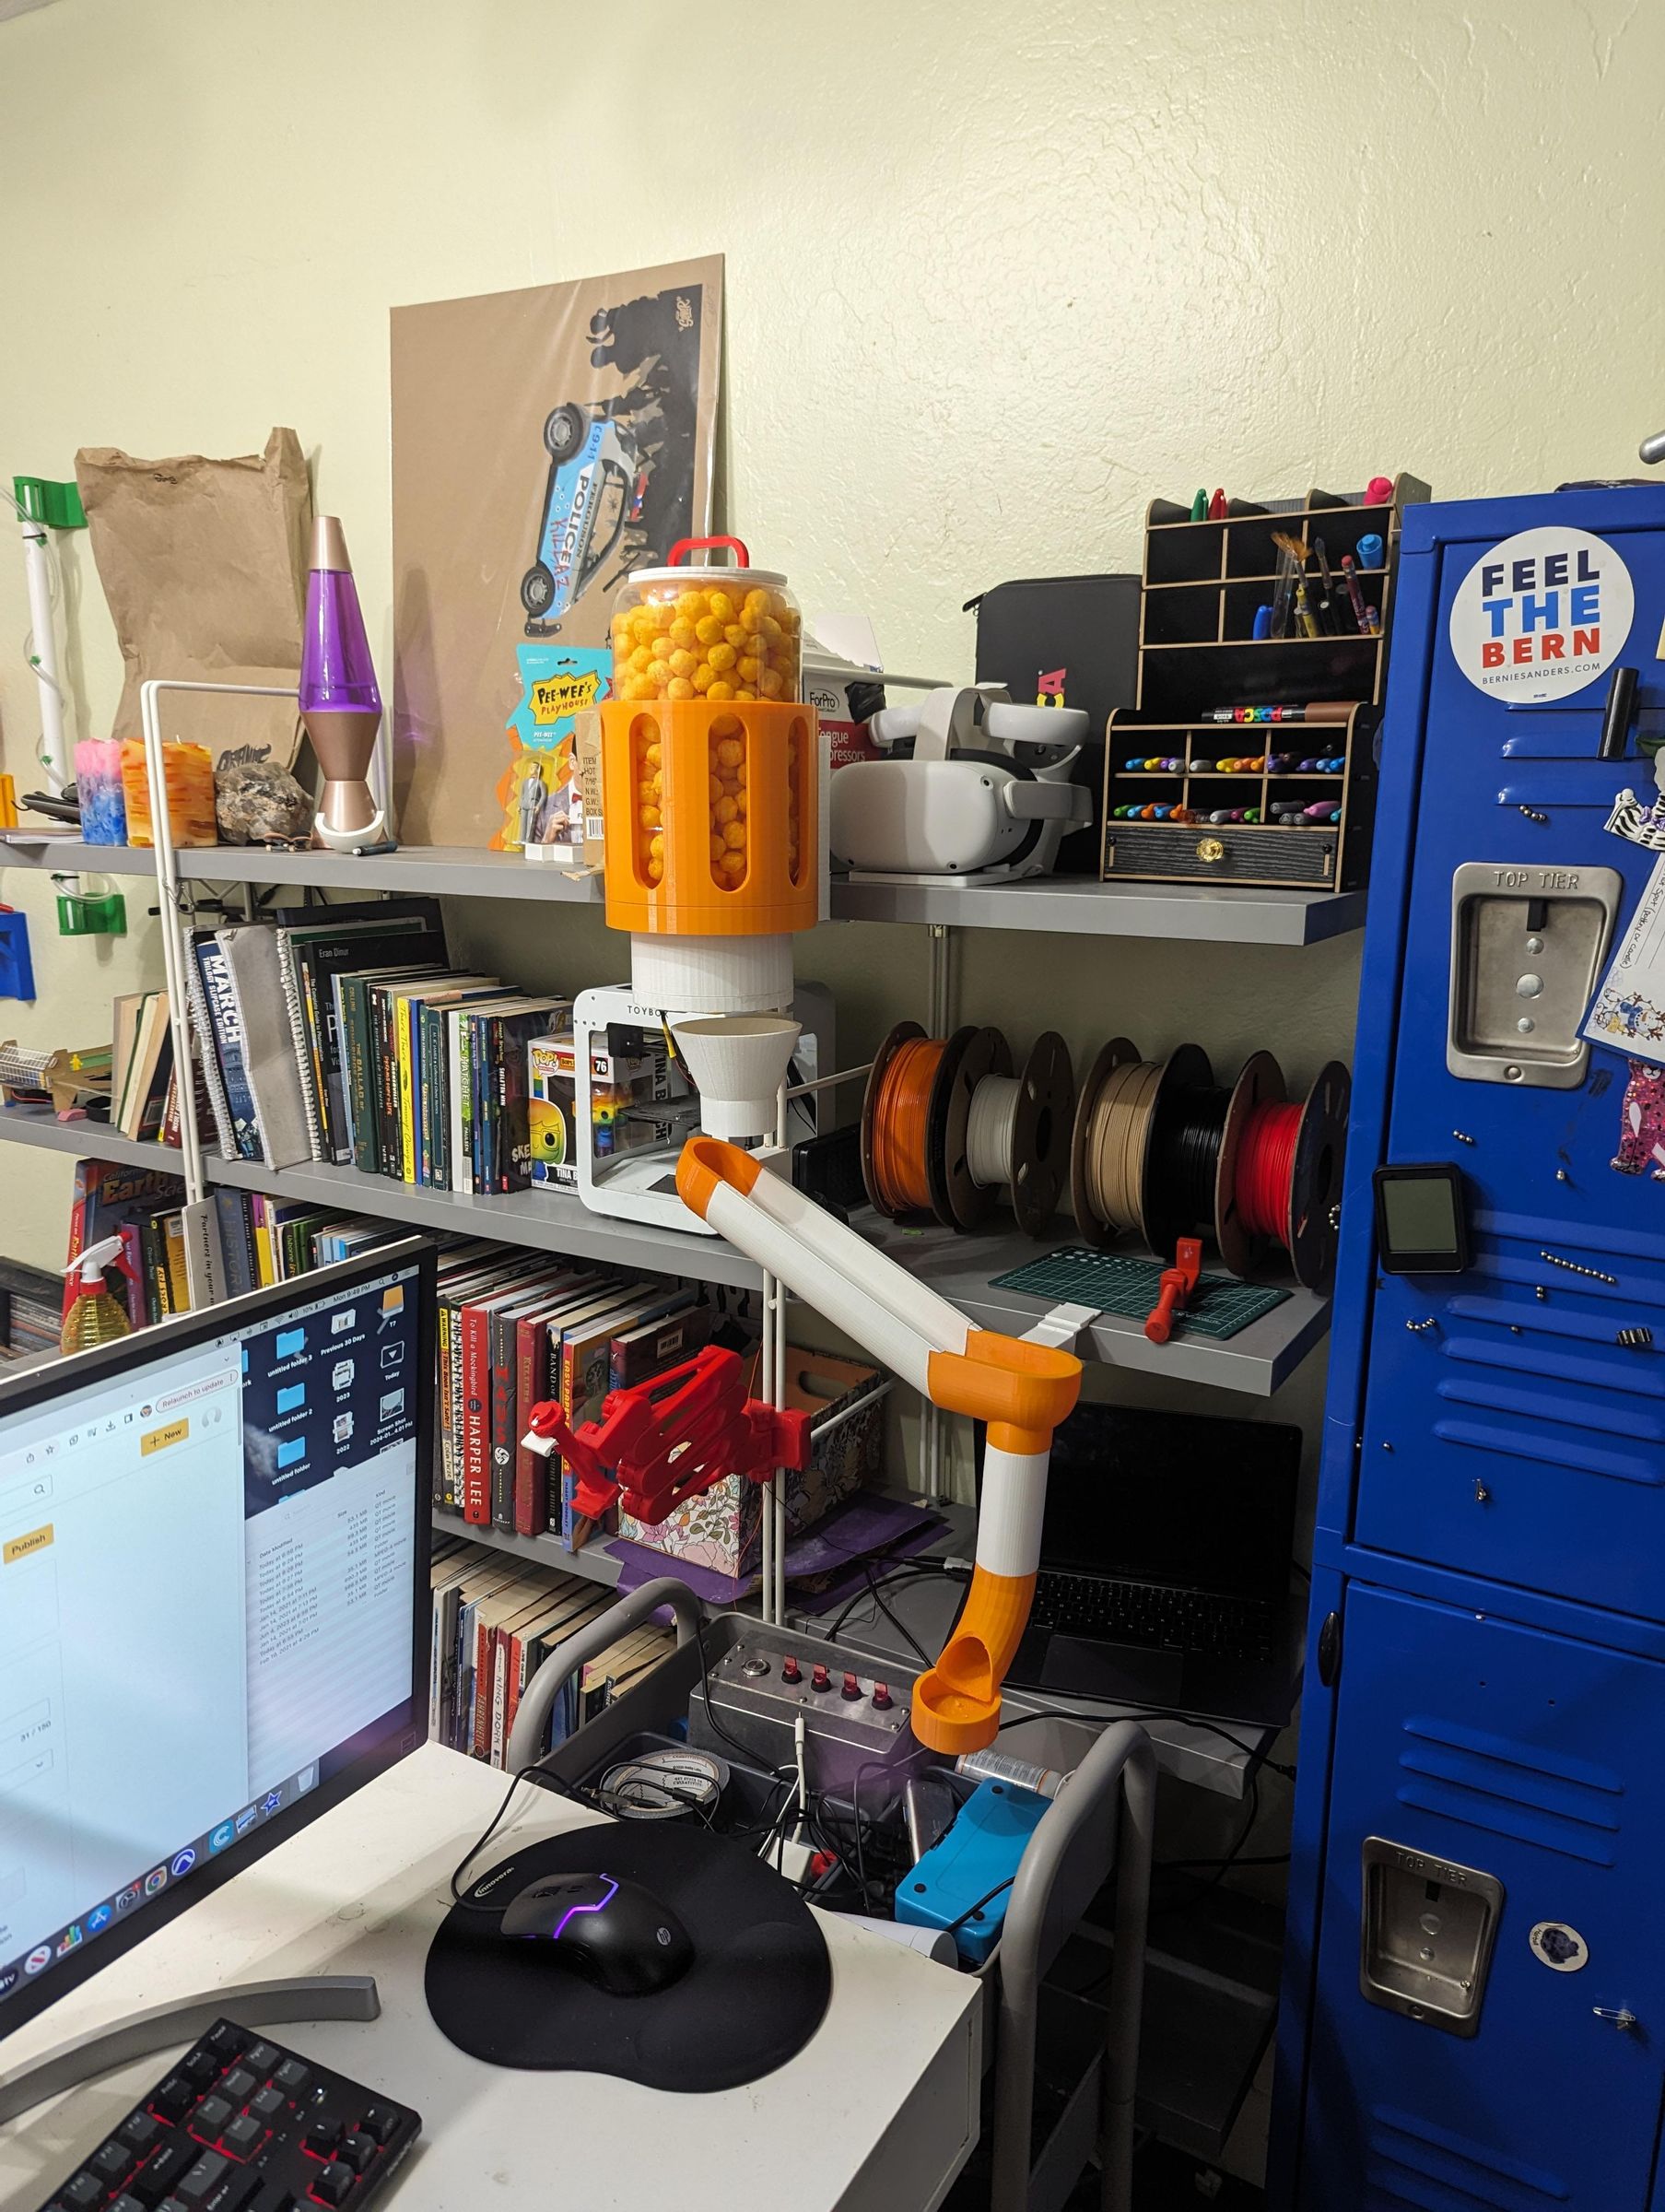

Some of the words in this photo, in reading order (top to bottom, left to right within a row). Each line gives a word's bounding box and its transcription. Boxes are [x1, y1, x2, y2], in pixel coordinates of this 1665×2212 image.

[560, 475, 590, 564] POLICE
[1482, 549, 1601, 598] FEEL
[1482, 584, 1601, 638] THE
[1482, 628, 1601, 669] BERN
[1482, 663, 1601, 685] BERNIESANDERS.COM
[537, 681, 593, 706] PEE-WEE'S
[809, 691, 837, 709] ForPro
[582, 756, 597, 766] ITEM
[1494, 870, 1530, 888] TOP
[1539, 872, 1580, 890] TIER
[319, 947, 333, 959] Eran
[202, 956, 215, 983] TRILOGY
[208, 983, 222, 1017] SLIPCASE
[210, 954, 241, 1044] MARCH
[216, 1017, 229, 1045] EDITION
[399, 1006, 408, 1031] There
[400, 1036, 409, 1062] There
[531, 1047, 558, 1068] POP!
[356, 1058, 367, 1098] BALLAD
[596, 1059, 608, 1074] 76
[461, 1055, 471, 1107] HATCHET
[102, 1165, 172, 1206] Earth
[556, 1166, 572, 1181] TINA
[155, 1181, 186, 1201] Scie
[201, 1214, 212, 1257] Partners
[205, 1260, 214, 1270] in
[205, 1272, 215, 1296] your
[333, 1293, 347, 1304] Mon
[360, 1283, 371, 1295] PM
[469, 1318, 477, 1328] To
[320, 1341, 345, 1357] Previous
[344, 1337, 353, 1347] 30
[353, 1333, 367, 1345] Days
[469, 1329, 477, 1343] Kill
[267, 1363, 290, 1379] untitled
[290, 1356, 309, 1371] folder
[385, 1371, 401, 1382] Today
[469, 1349, 478, 1396] Mockingbird
[550, 1352, 559, 1383] BAND
[563, 1359, 571, 1382] EASY
[162, 1391, 193, 1409] Relaunch
[193, 1386, 201, 1395] to
[201, 1379, 224, 1394] update
[335, 1392, 351, 1404] 2023
[268, 1418, 291, 1433] untitled
[290, 1410, 309, 1426] folder
[164, 1429, 182, 1441] New
[469, 1415, 482, 1474] HARPER
[272, 1471, 294, 1487] untitled
[293, 1463, 311, 1478] folder
[470, 1479, 482, 1506] LEE
[11, 1534, 47, 1557] Publish
[495, 1675, 503, 1706] KING
[475, 1692, 487, 1746] FAHRENHEIT
[494, 1711, 502, 1745] DORK
[478, 1867, 512, 1895] innovera
[1396, 1851, 1425, 1868] TOP
[1434, 1863, 1467, 1886] TIER
